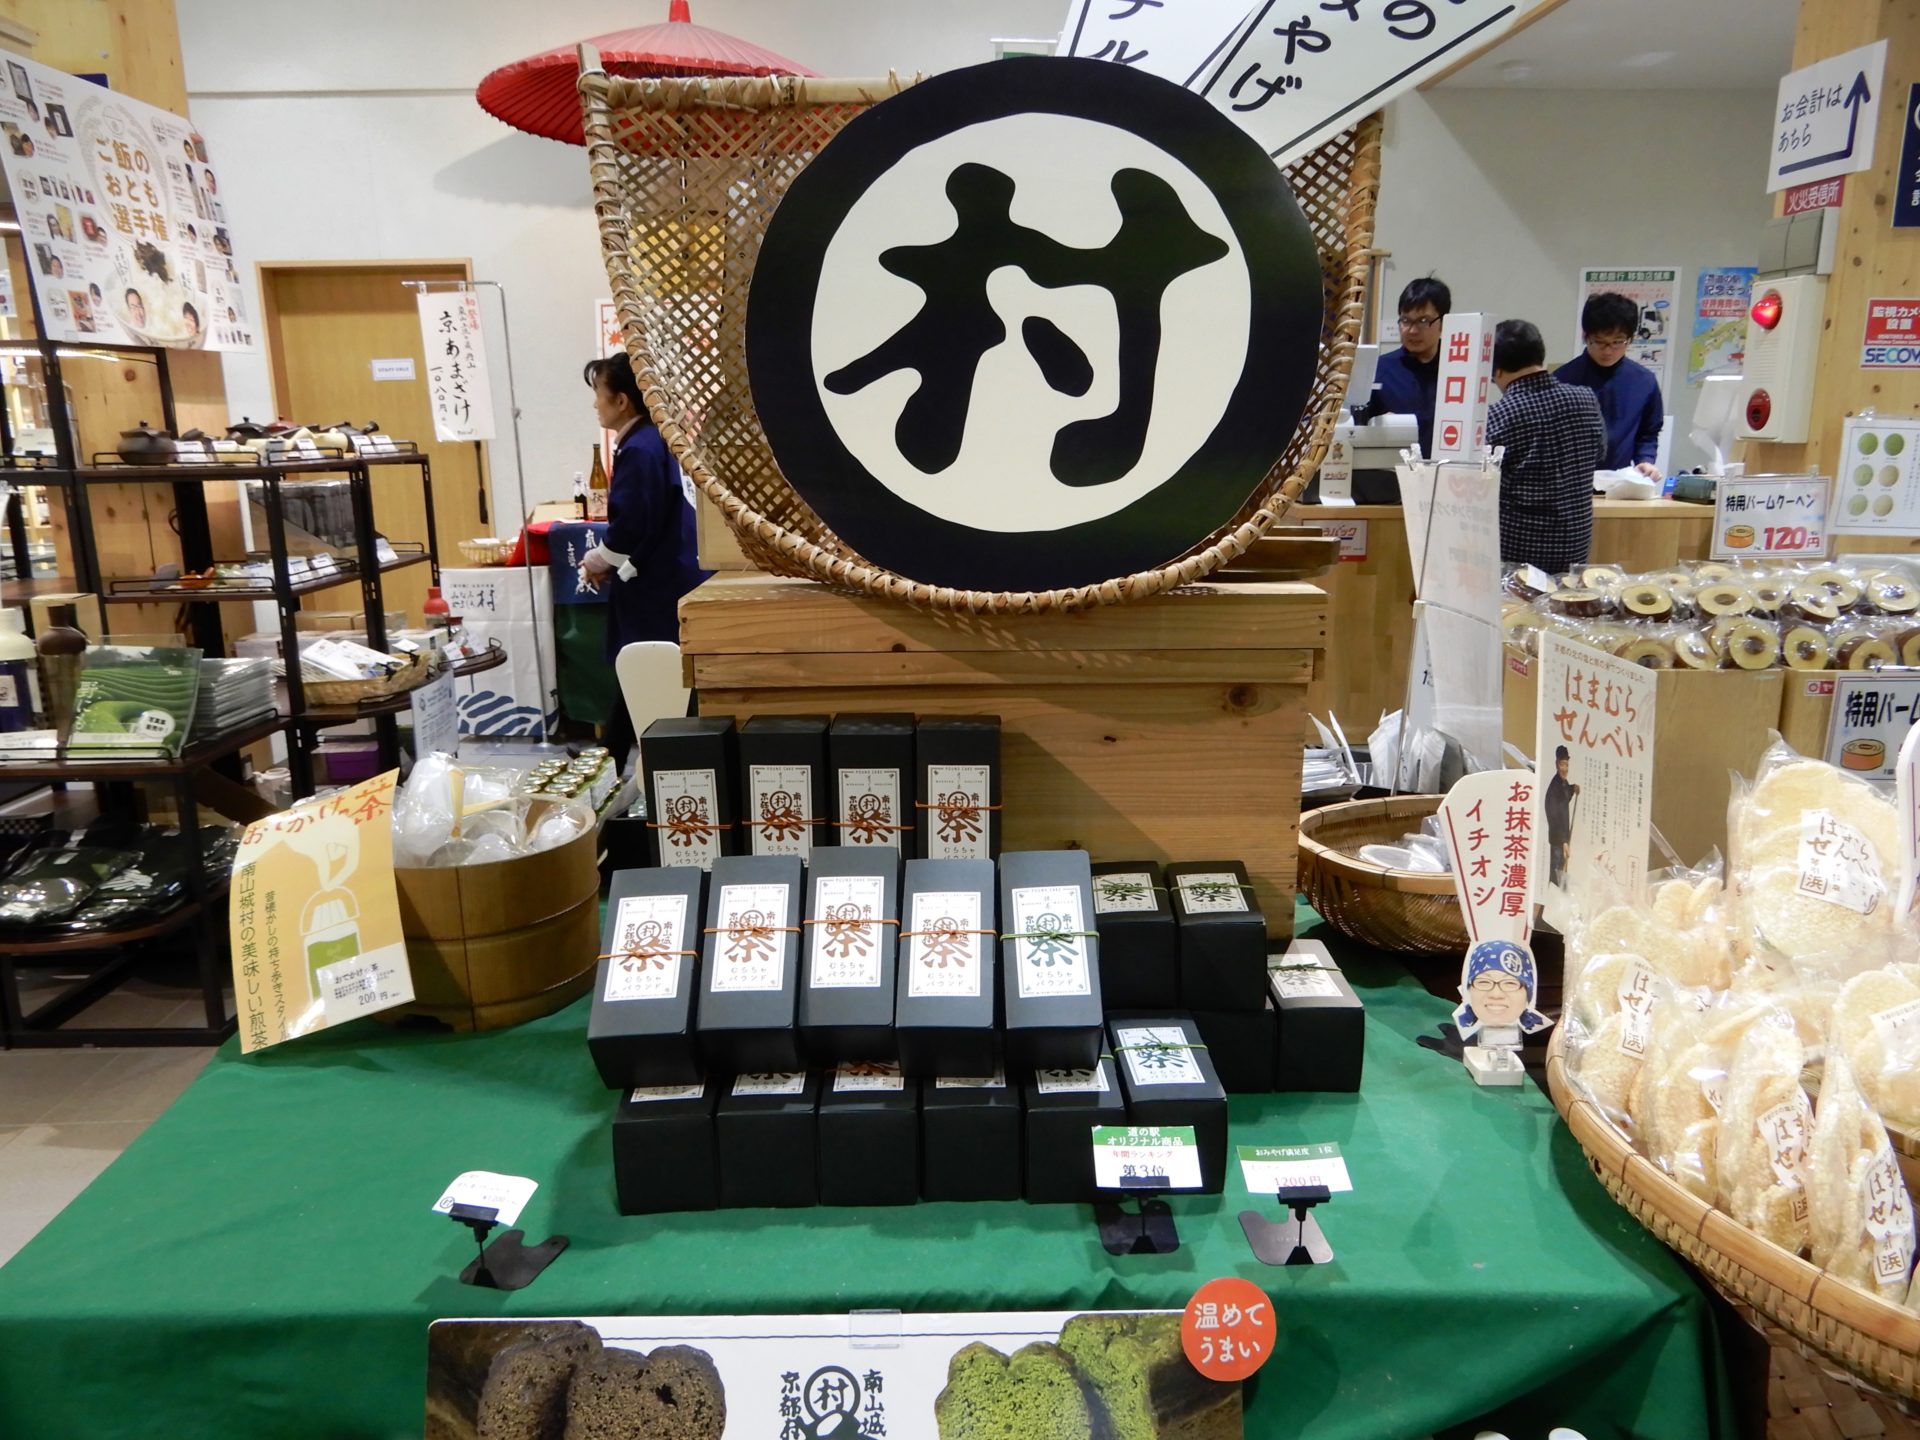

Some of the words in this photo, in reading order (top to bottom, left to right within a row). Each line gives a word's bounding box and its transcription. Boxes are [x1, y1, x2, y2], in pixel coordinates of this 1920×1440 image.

[1780, 84, 1844, 123] お会計は
[1777, 123, 1812, 153] あちら
[96, 138, 150, 174] ご飯の
[104, 171, 159, 208] おとも
[1787, 180, 1840, 213] 火災受信所
[111, 203, 170, 242] 選手権
[1704, 285, 1752, 296] 記念きっ
[823, 162, 1230, 488] 村
[1871, 306, 1920, 318] 監視カメ
[1886, 318, 1912, 330] 設置
[438, 311, 471, 424] 京あまざけ
[1444, 332, 1470, 404] 出口
[1477, 332, 1493, 404] 出口
[1725, 494, 1815, 512] 特用バームクーヘン
[1322, 524, 1357, 537] うパック
[1565, 663, 1637, 722] はまむら
[1553, 705, 1644, 758] せんべい
[680, 800, 692, 811] 村
[774, 795, 787, 807] 村
[862, 797, 875, 810] 村
[1465, 799, 1496, 907] イチオシ
[1499, 781, 1533, 917] お抹茶濃厚
[837, 907, 855, 921] 村
[1042, 917, 1056, 932] 村
[639, 924, 656, 938] 村
[822, 923, 874, 958] 茶
[239, 861, 269, 1051] 南山城村の美味しい煎茶
[724, 931, 777, 963] 茶
[920, 935, 972, 968] 茶
[728, 974, 767, 982] パウンド
[730, 966, 766, 974] むらちゃ
[828, 970, 865, 978] パウンド
[622, 983, 662, 991] パウンド
[1107, 1136, 1183, 1146] オリジナル商品
[1128, 1126, 1160, 1137] 道の駅
[1113, 1150, 1173, 1158] 年間ランキング
[1122, 1164, 1164, 1177] 第3位
[1869, 1162, 1896, 1201] はま
[1868, 1191, 1902, 1225] せん
[1194, 1303, 1265, 1329] 温めて
[1200, 1335, 1261, 1364] うまい
[813, 1377, 849, 1411] 村
[862, 1368, 887, 1437] 南山城
